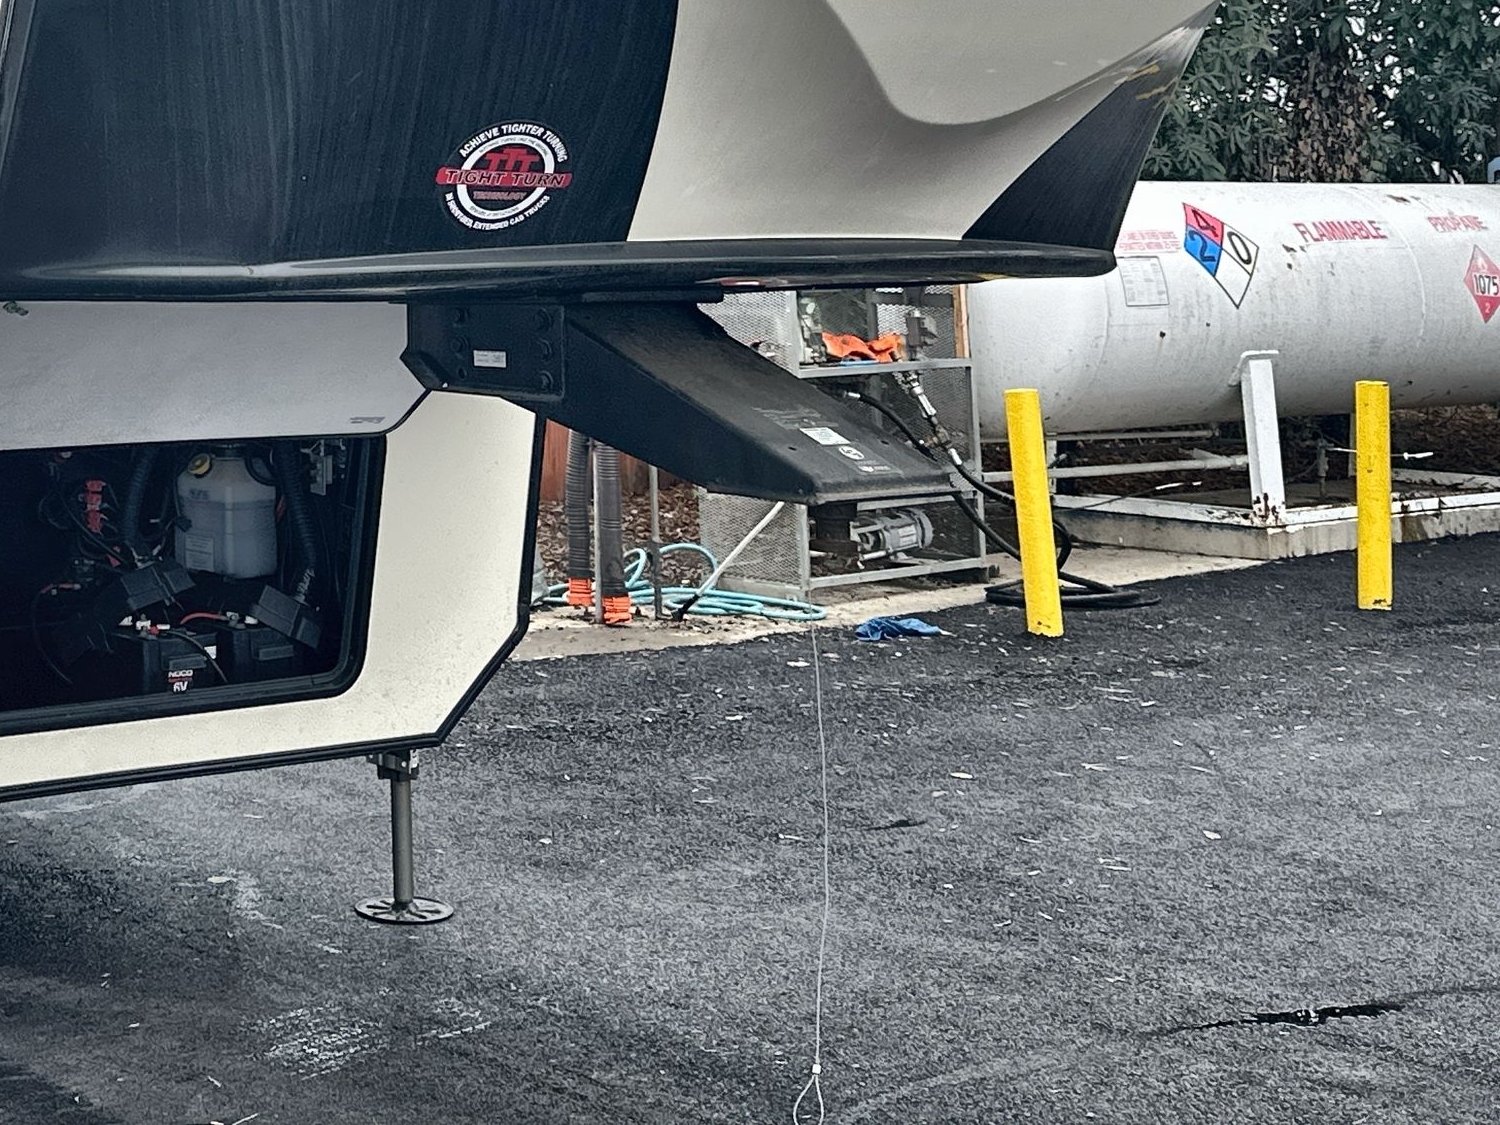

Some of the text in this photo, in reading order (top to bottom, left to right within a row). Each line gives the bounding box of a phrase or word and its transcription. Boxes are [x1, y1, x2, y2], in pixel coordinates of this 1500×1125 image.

[459, 127, 500, 157] ACHIEVE
[501, 124, 545, 137] TIGHTER
[543, 129, 568, 163] TURNING
[445, 170, 565, 187] TIGHT TURN
[509, 213, 525, 225] CAB
[525, 195, 550, 218] TRUCKS
[1191, 209, 1219, 237] 4
[1293, 220, 1388, 242] FLAMMABLE
[1427, 216, 1489, 233] PROPANE
[1188, 230, 1216, 262] 2
[1227, 231, 1252, 265] 0
[1474, 274, 1499, 295] 1075
[1485, 302, 1491, 313] 2
